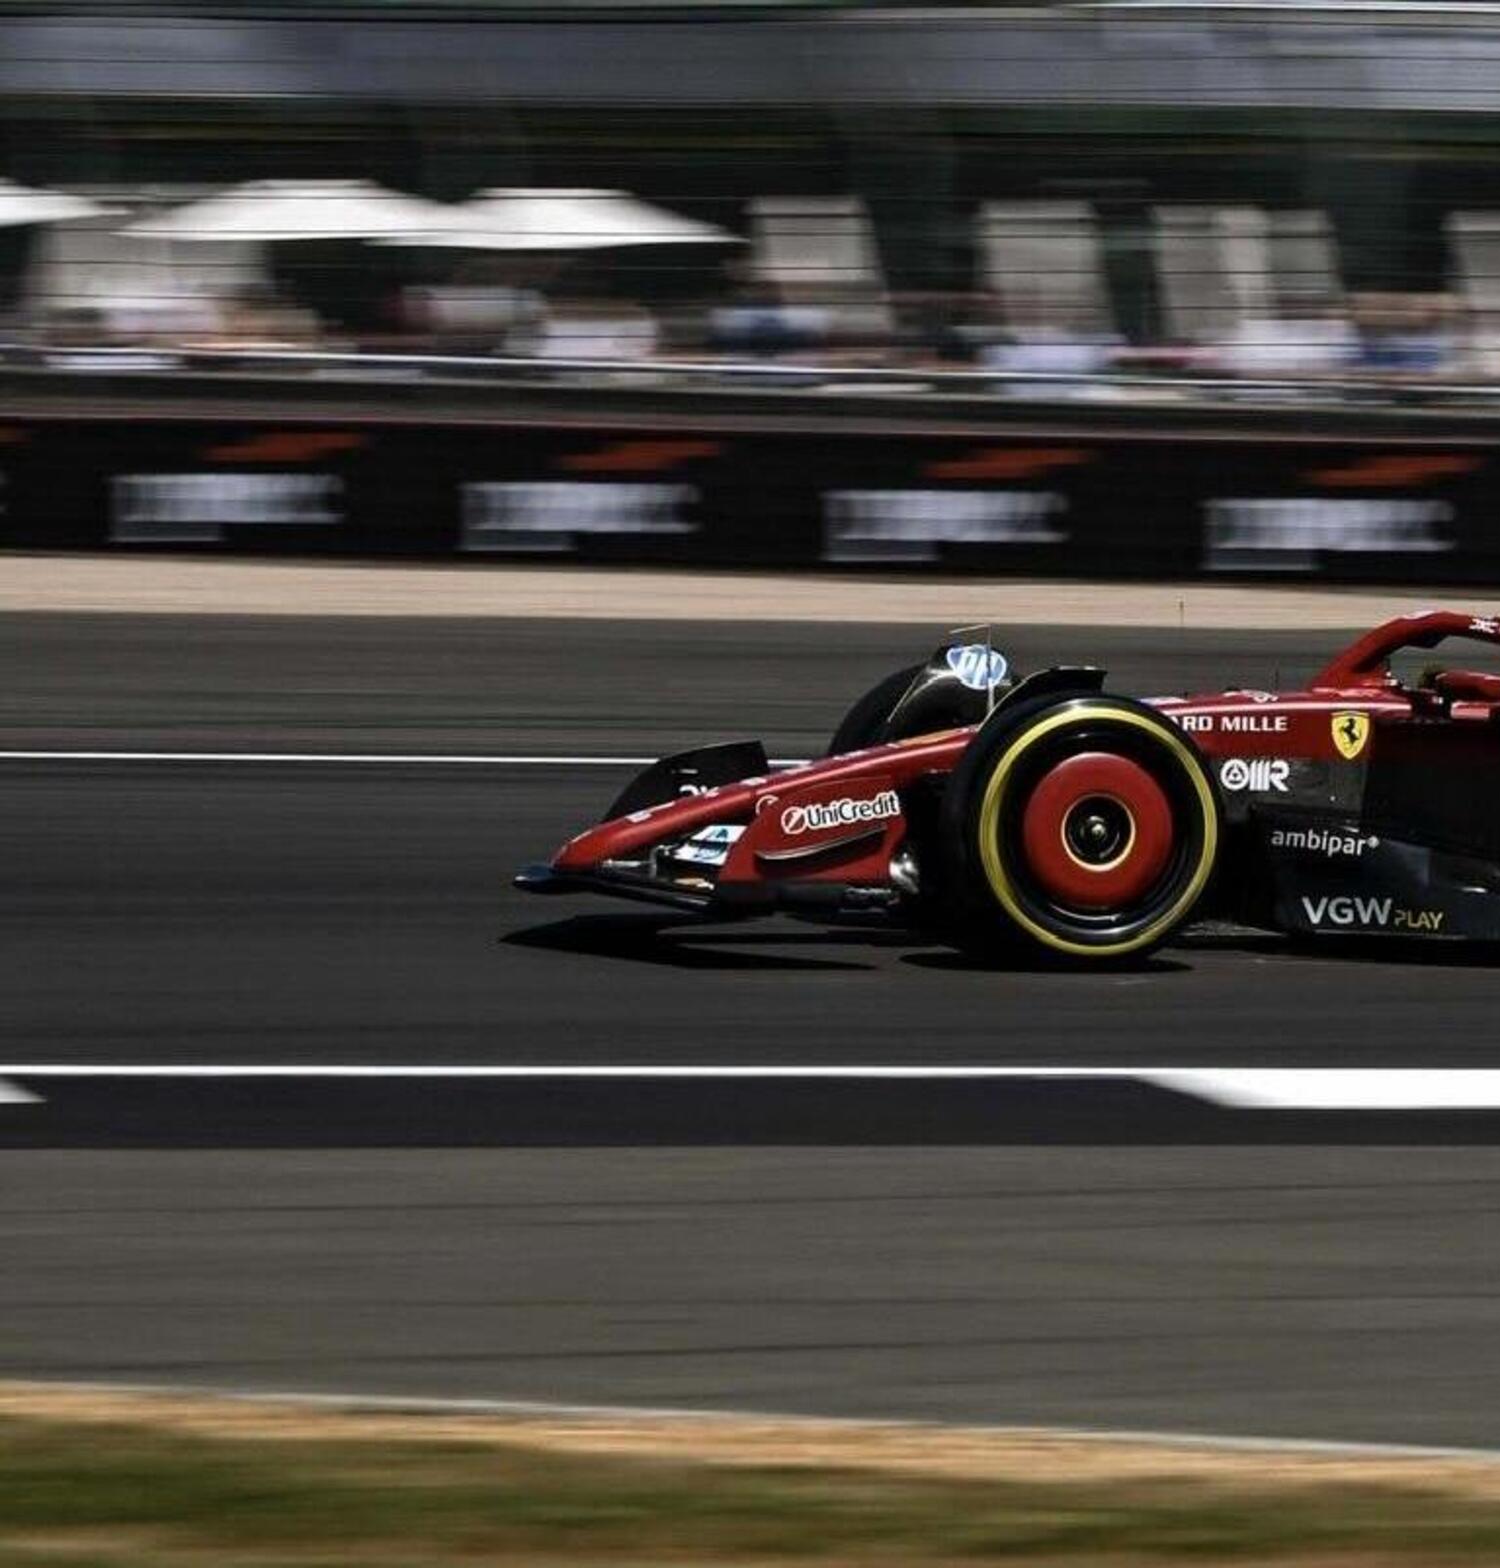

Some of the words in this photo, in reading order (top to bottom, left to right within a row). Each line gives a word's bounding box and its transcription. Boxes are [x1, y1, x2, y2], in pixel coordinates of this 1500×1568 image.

[1220, 715, 1288, 732] MILLE
[804, 790, 901, 829] UniCredit
[1271, 829, 1367, 857] ambipar
[1302, 897, 1393, 925] VGW
[1394, 909, 1444, 930] PLAY
